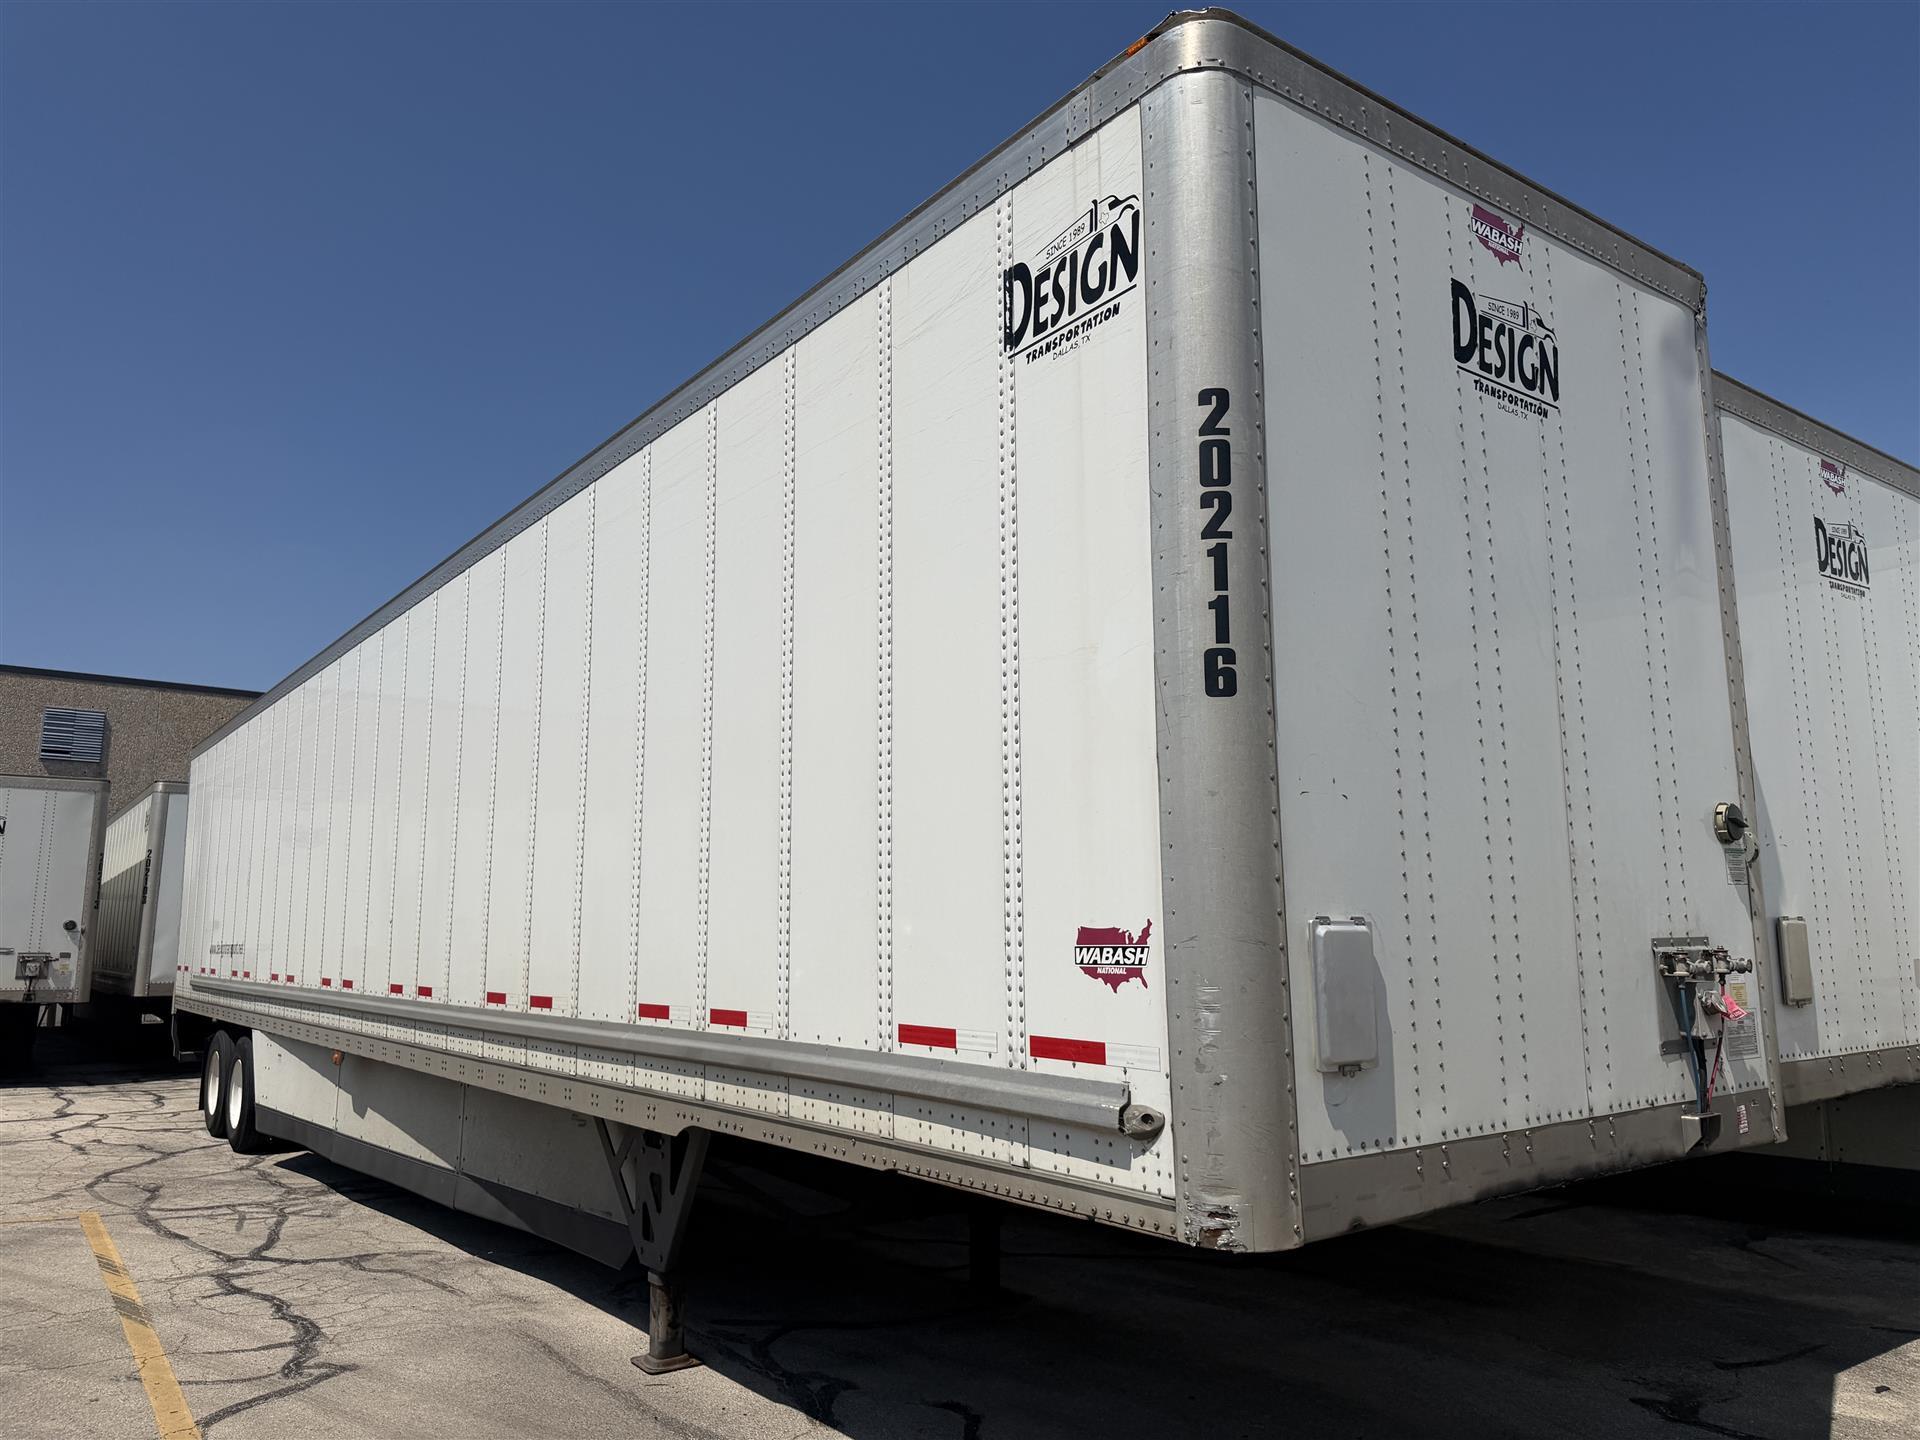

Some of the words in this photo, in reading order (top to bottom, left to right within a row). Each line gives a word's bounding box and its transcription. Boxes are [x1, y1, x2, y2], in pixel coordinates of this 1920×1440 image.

[1046, 235, 1067, 259] SINCE
[1069, 222, 1085, 242] 1989
[1471, 218, 1523, 255] WABASH
[1003, 209, 1140, 352] DESIGN
[1487, 301, 1506, 316] SINCE
[1506, 307, 1520, 320] 1989
[1025, 301, 1121, 365] TRANSPORTATION
[1052, 340, 1080, 361] DALLAS,
[1081, 333, 1092, 345] TX
[1451, 277, 1560, 402] DESIGN
[1473, 378, 1549, 419] TRANSPORTATION
[1521, 411, 1529, 421] TX
[1820, 468, 1846, 486] WABASH
[1198, 387, 1238, 698] 202116
[1813, 515, 1870, 585] DESIGN
[1074, 947, 1150, 965] WABASH
[1096, 967, 1127, 975] NATIONAL
